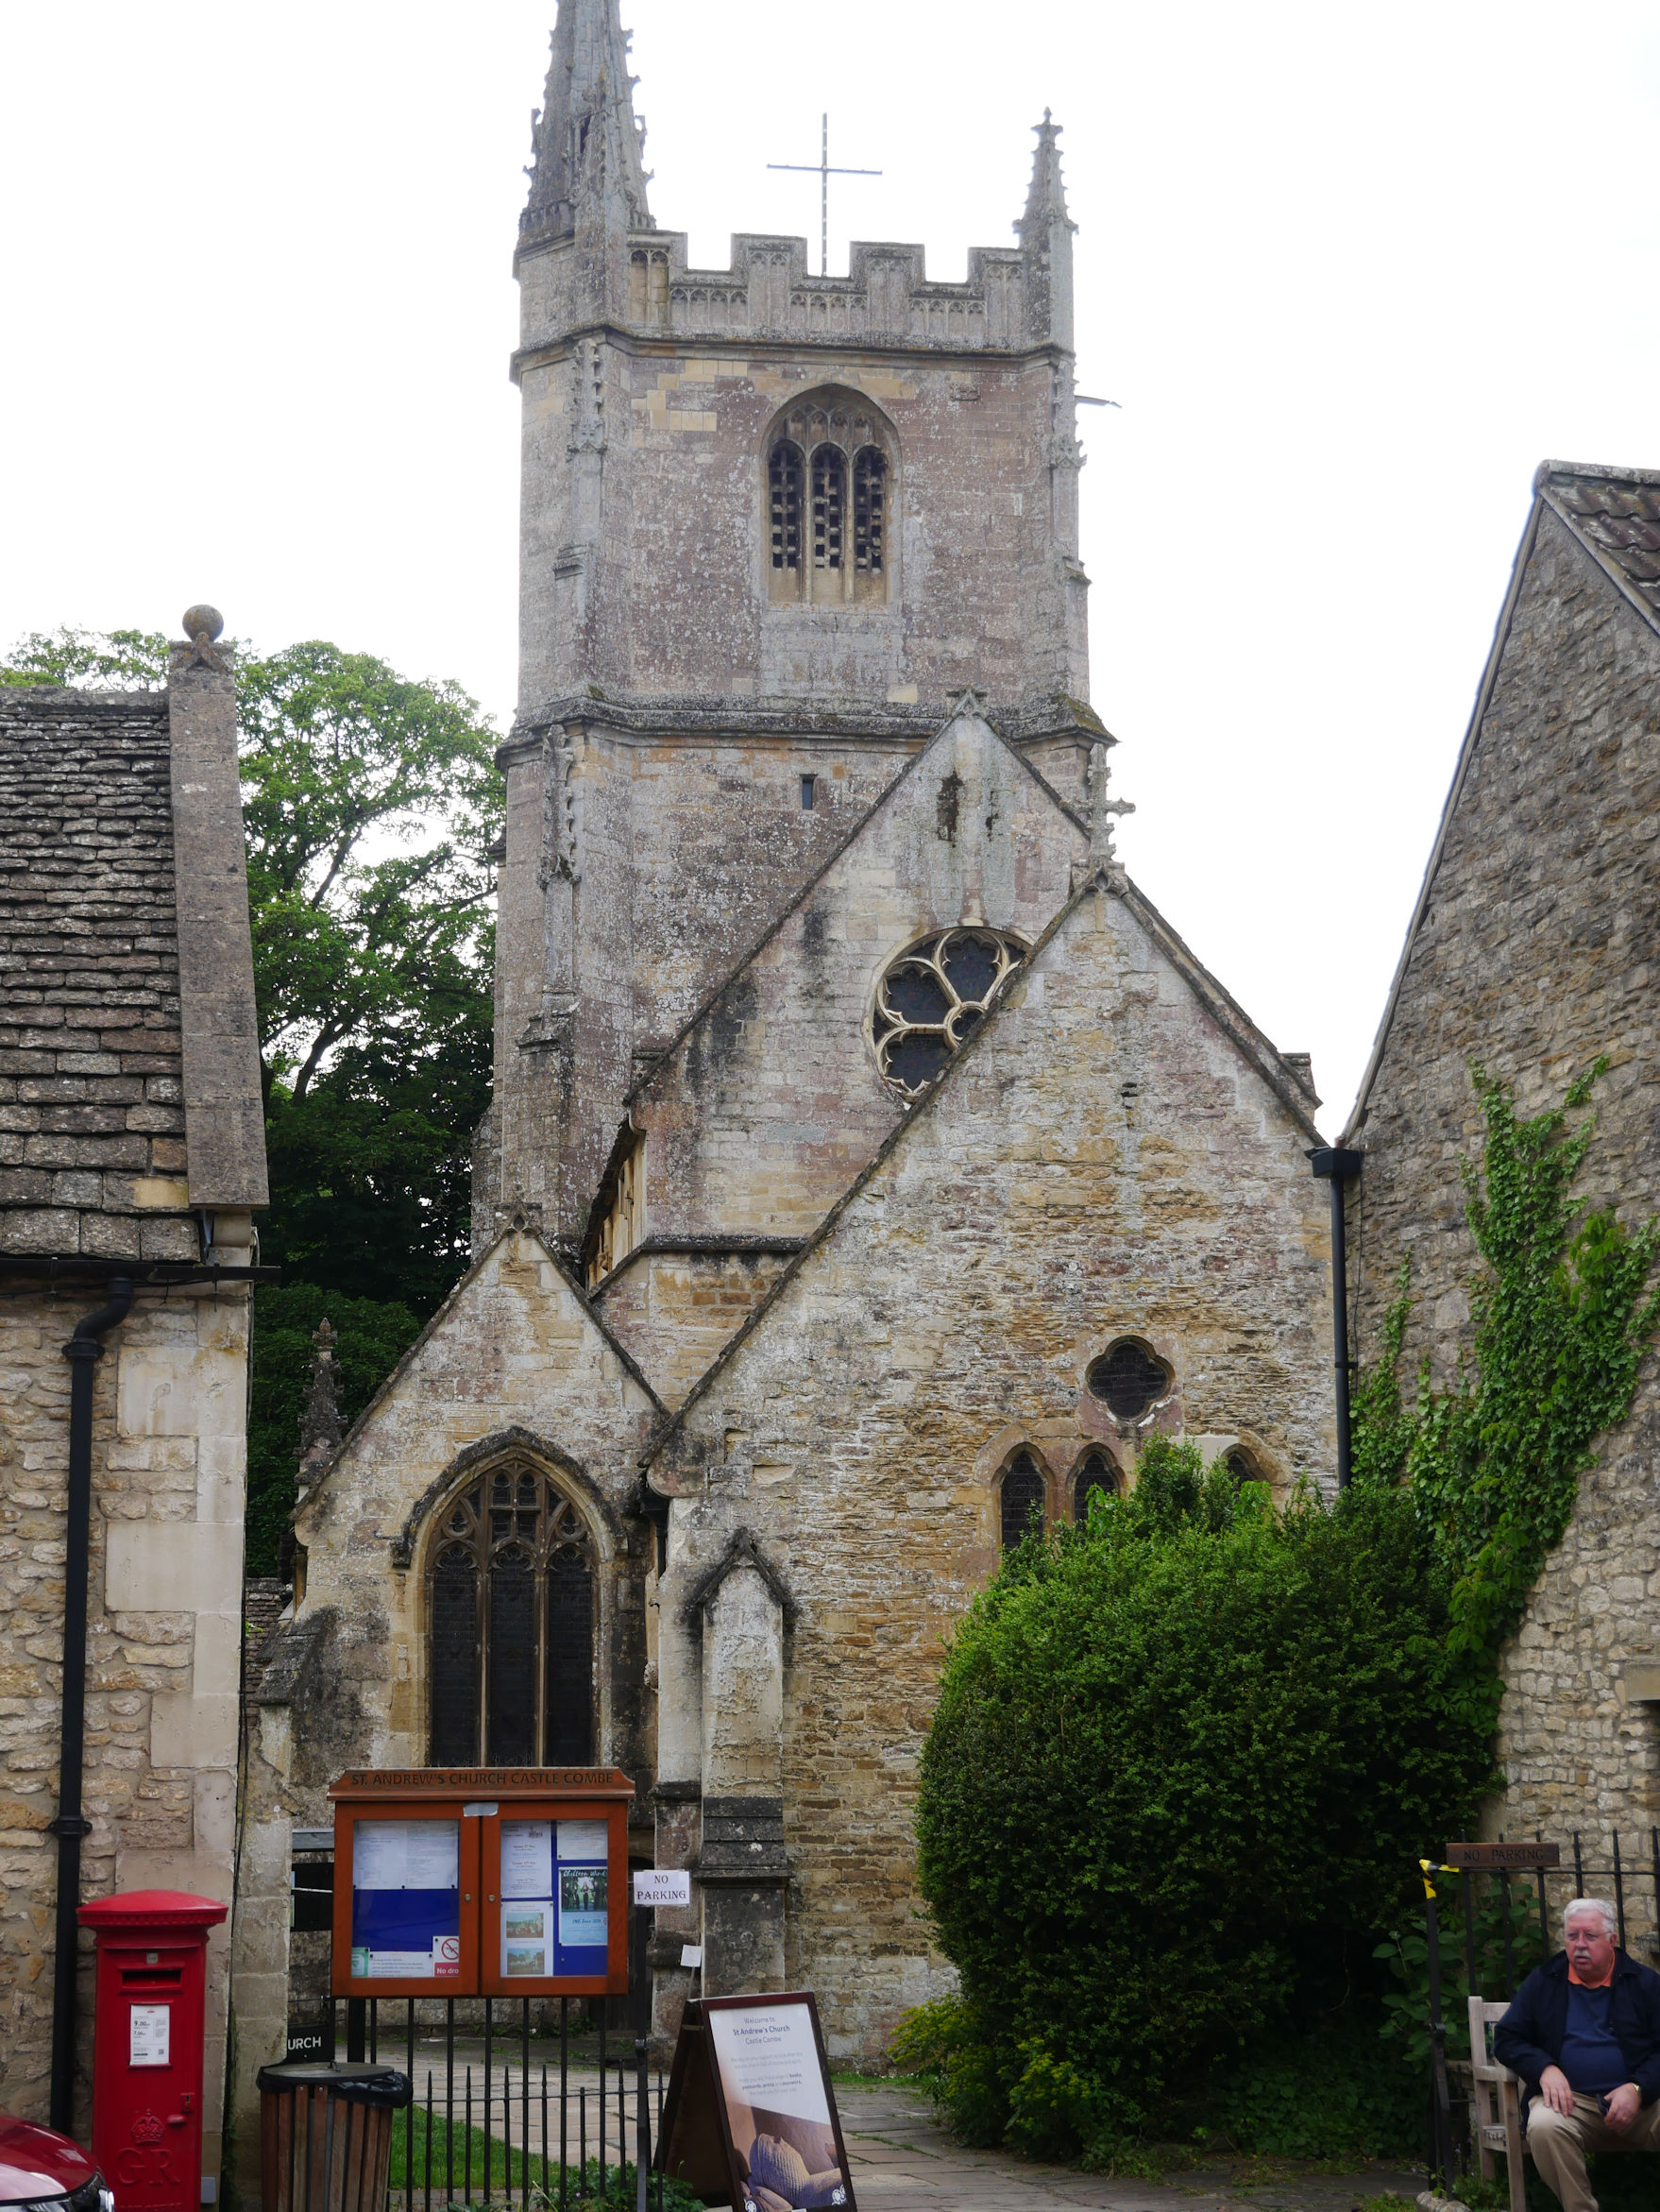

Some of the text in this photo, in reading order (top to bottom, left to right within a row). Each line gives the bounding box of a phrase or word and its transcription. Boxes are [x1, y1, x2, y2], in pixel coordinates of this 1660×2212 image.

[351, 1772, 613, 1785] ST. ANDREW'S CHURCH CASTLE COMBE
[1464, 1848, 1543, 1861] NO PARKING
[654, 1875, 669, 1884] NO
[636, 1890, 686, 1900] PARKING
[740, 2026, 769, 2035] Andrew's
[769, 2024, 790, 2033] Church
